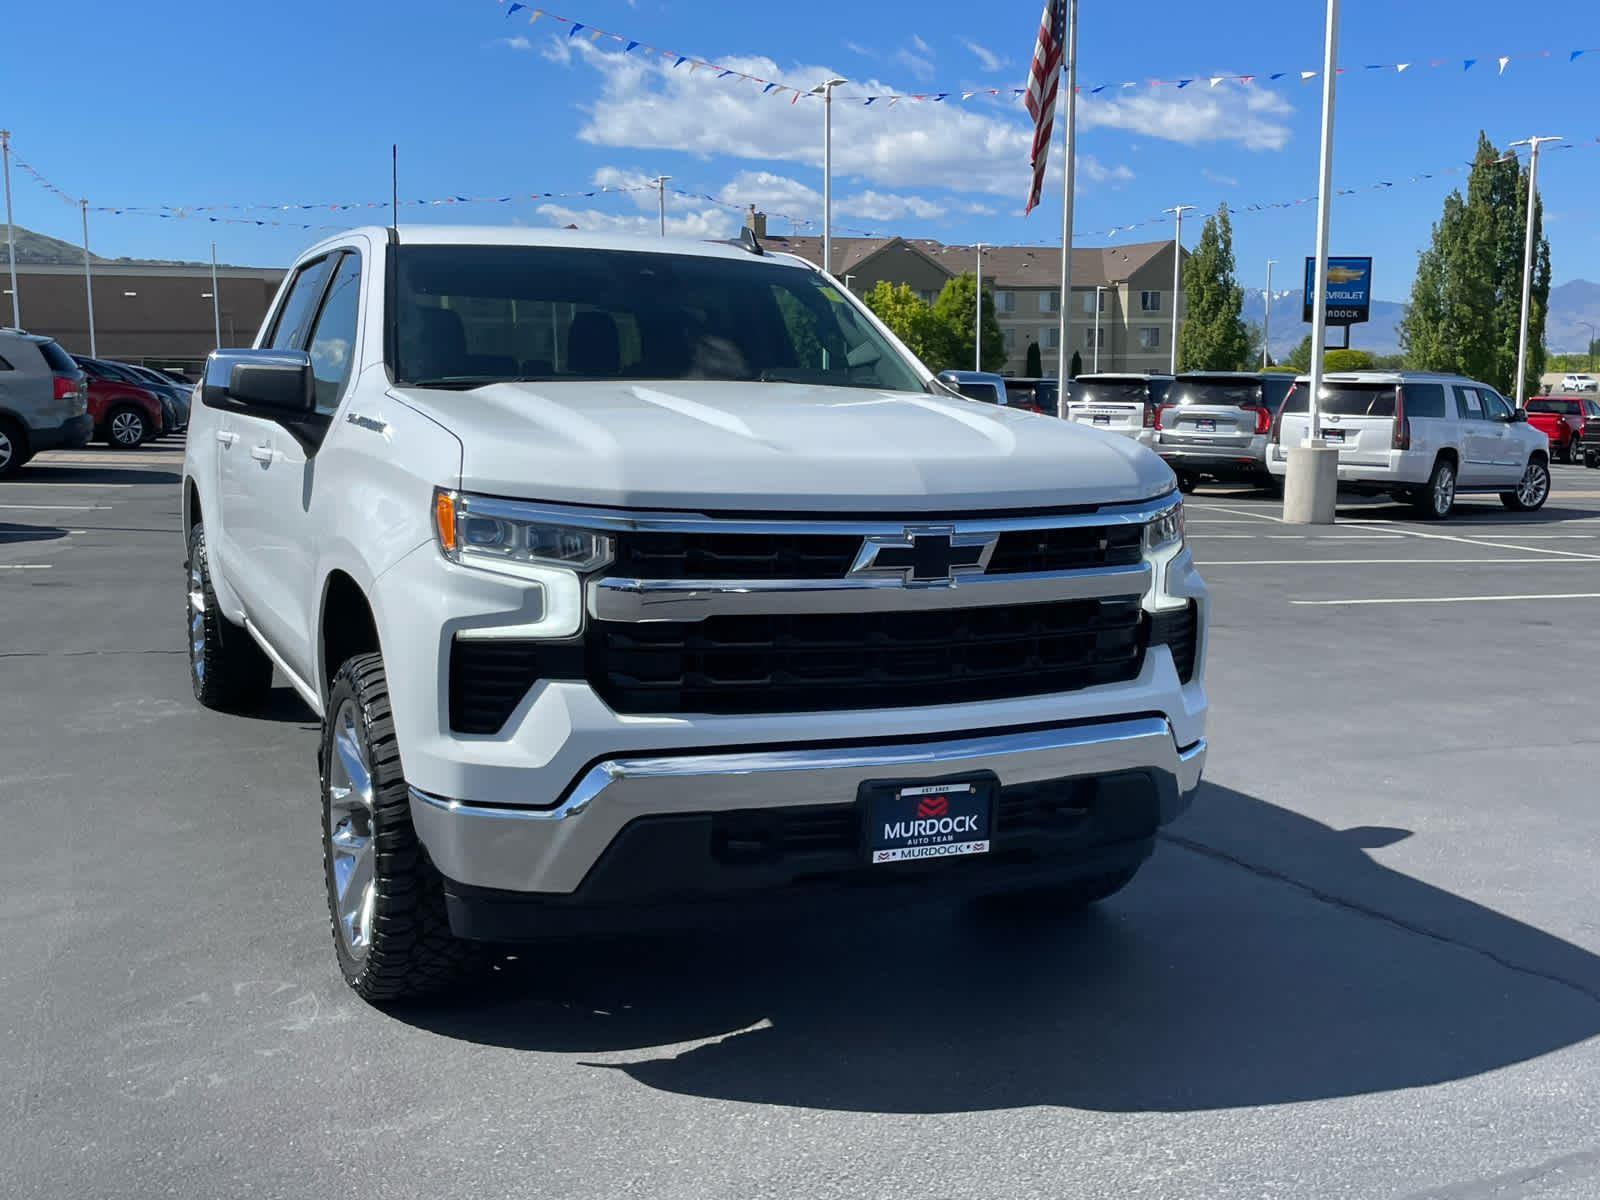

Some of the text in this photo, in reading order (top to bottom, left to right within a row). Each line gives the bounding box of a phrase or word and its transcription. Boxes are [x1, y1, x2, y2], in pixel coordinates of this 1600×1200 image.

[1310, 291, 1364, 300] CEVROLET
[884, 815, 977, 839] MURDOCK
[908, 835, 953, 846] AUTO TEAM
[901, 844, 964, 858] MURDOCK
